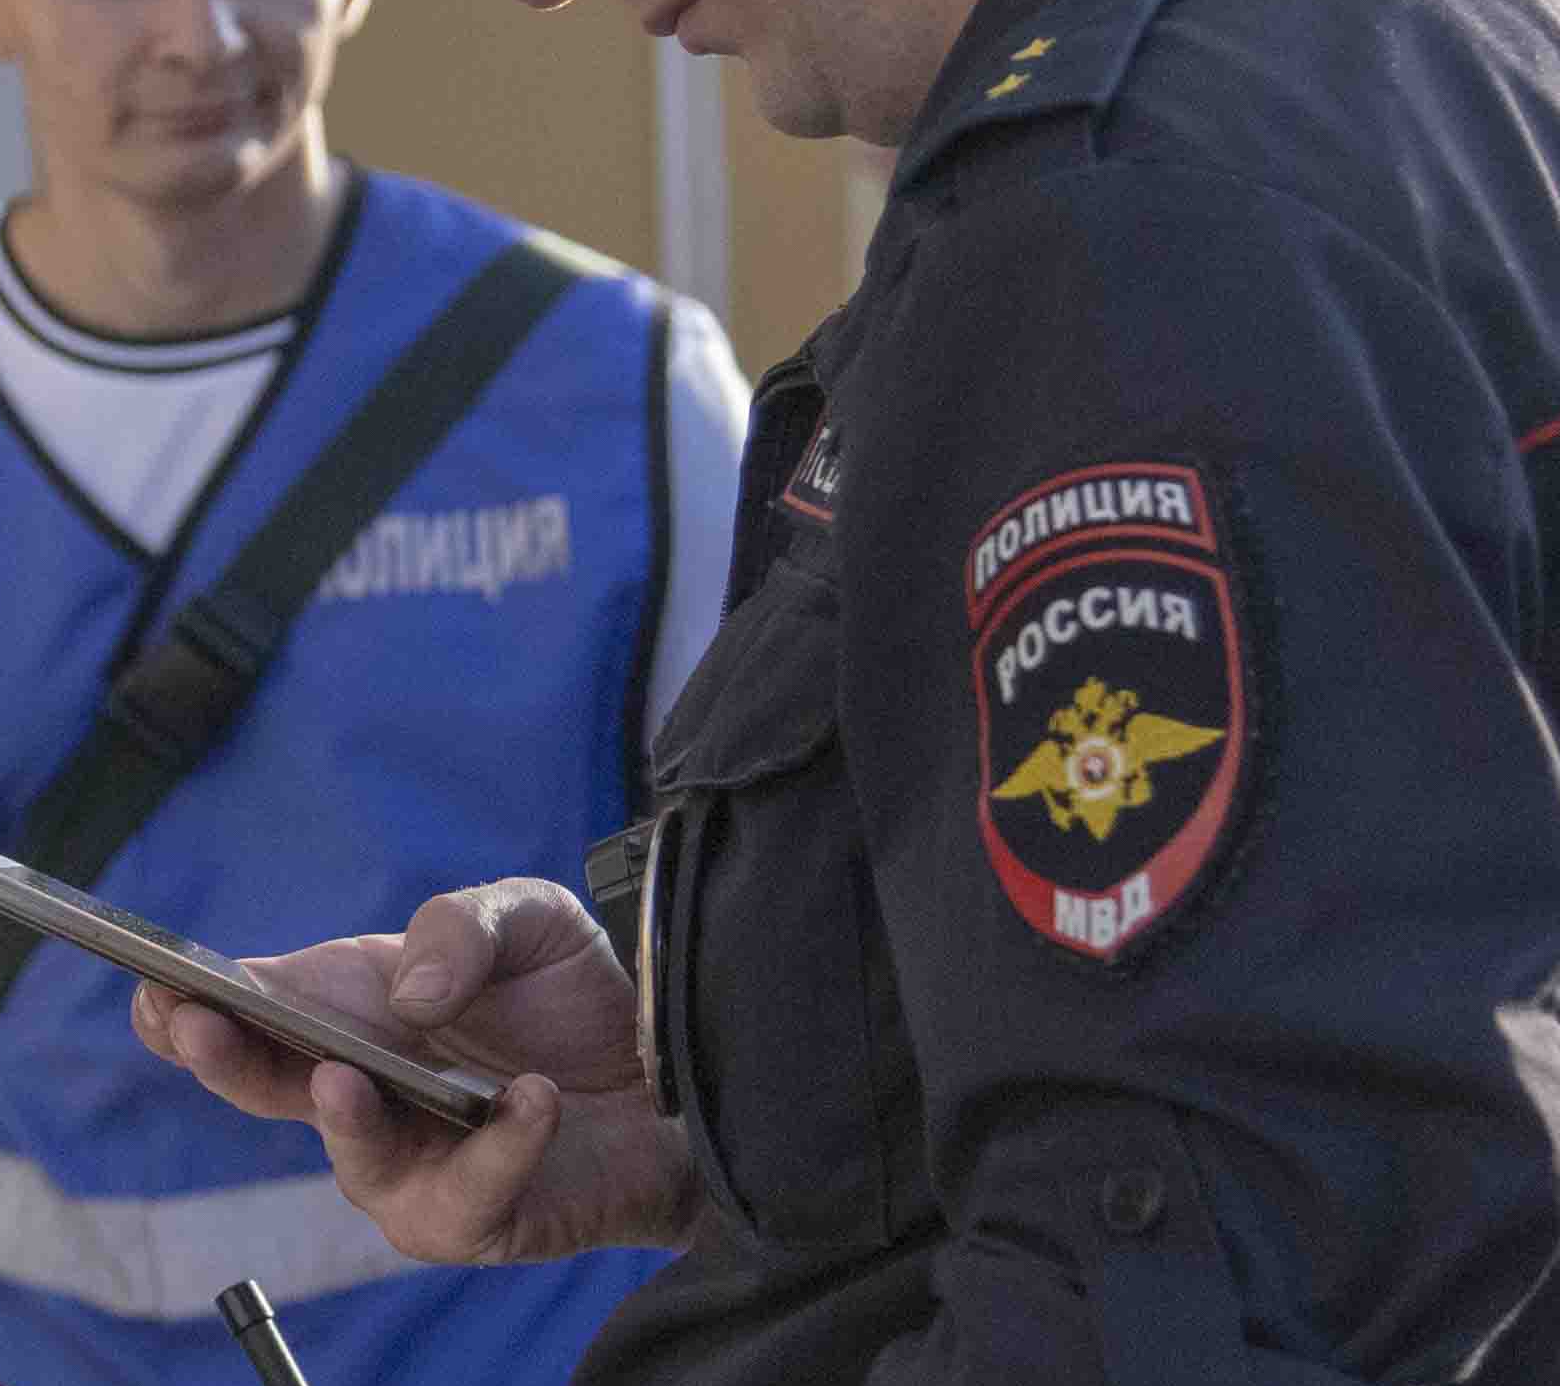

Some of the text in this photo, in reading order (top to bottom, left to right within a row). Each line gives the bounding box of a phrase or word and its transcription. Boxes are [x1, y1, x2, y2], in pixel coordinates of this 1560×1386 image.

[974, 479, 1192, 590] ПОЛИЦИЯ
[996, 586, 1198, 703] РОССИЯ
[1054, 872, 1154, 951] МВД
